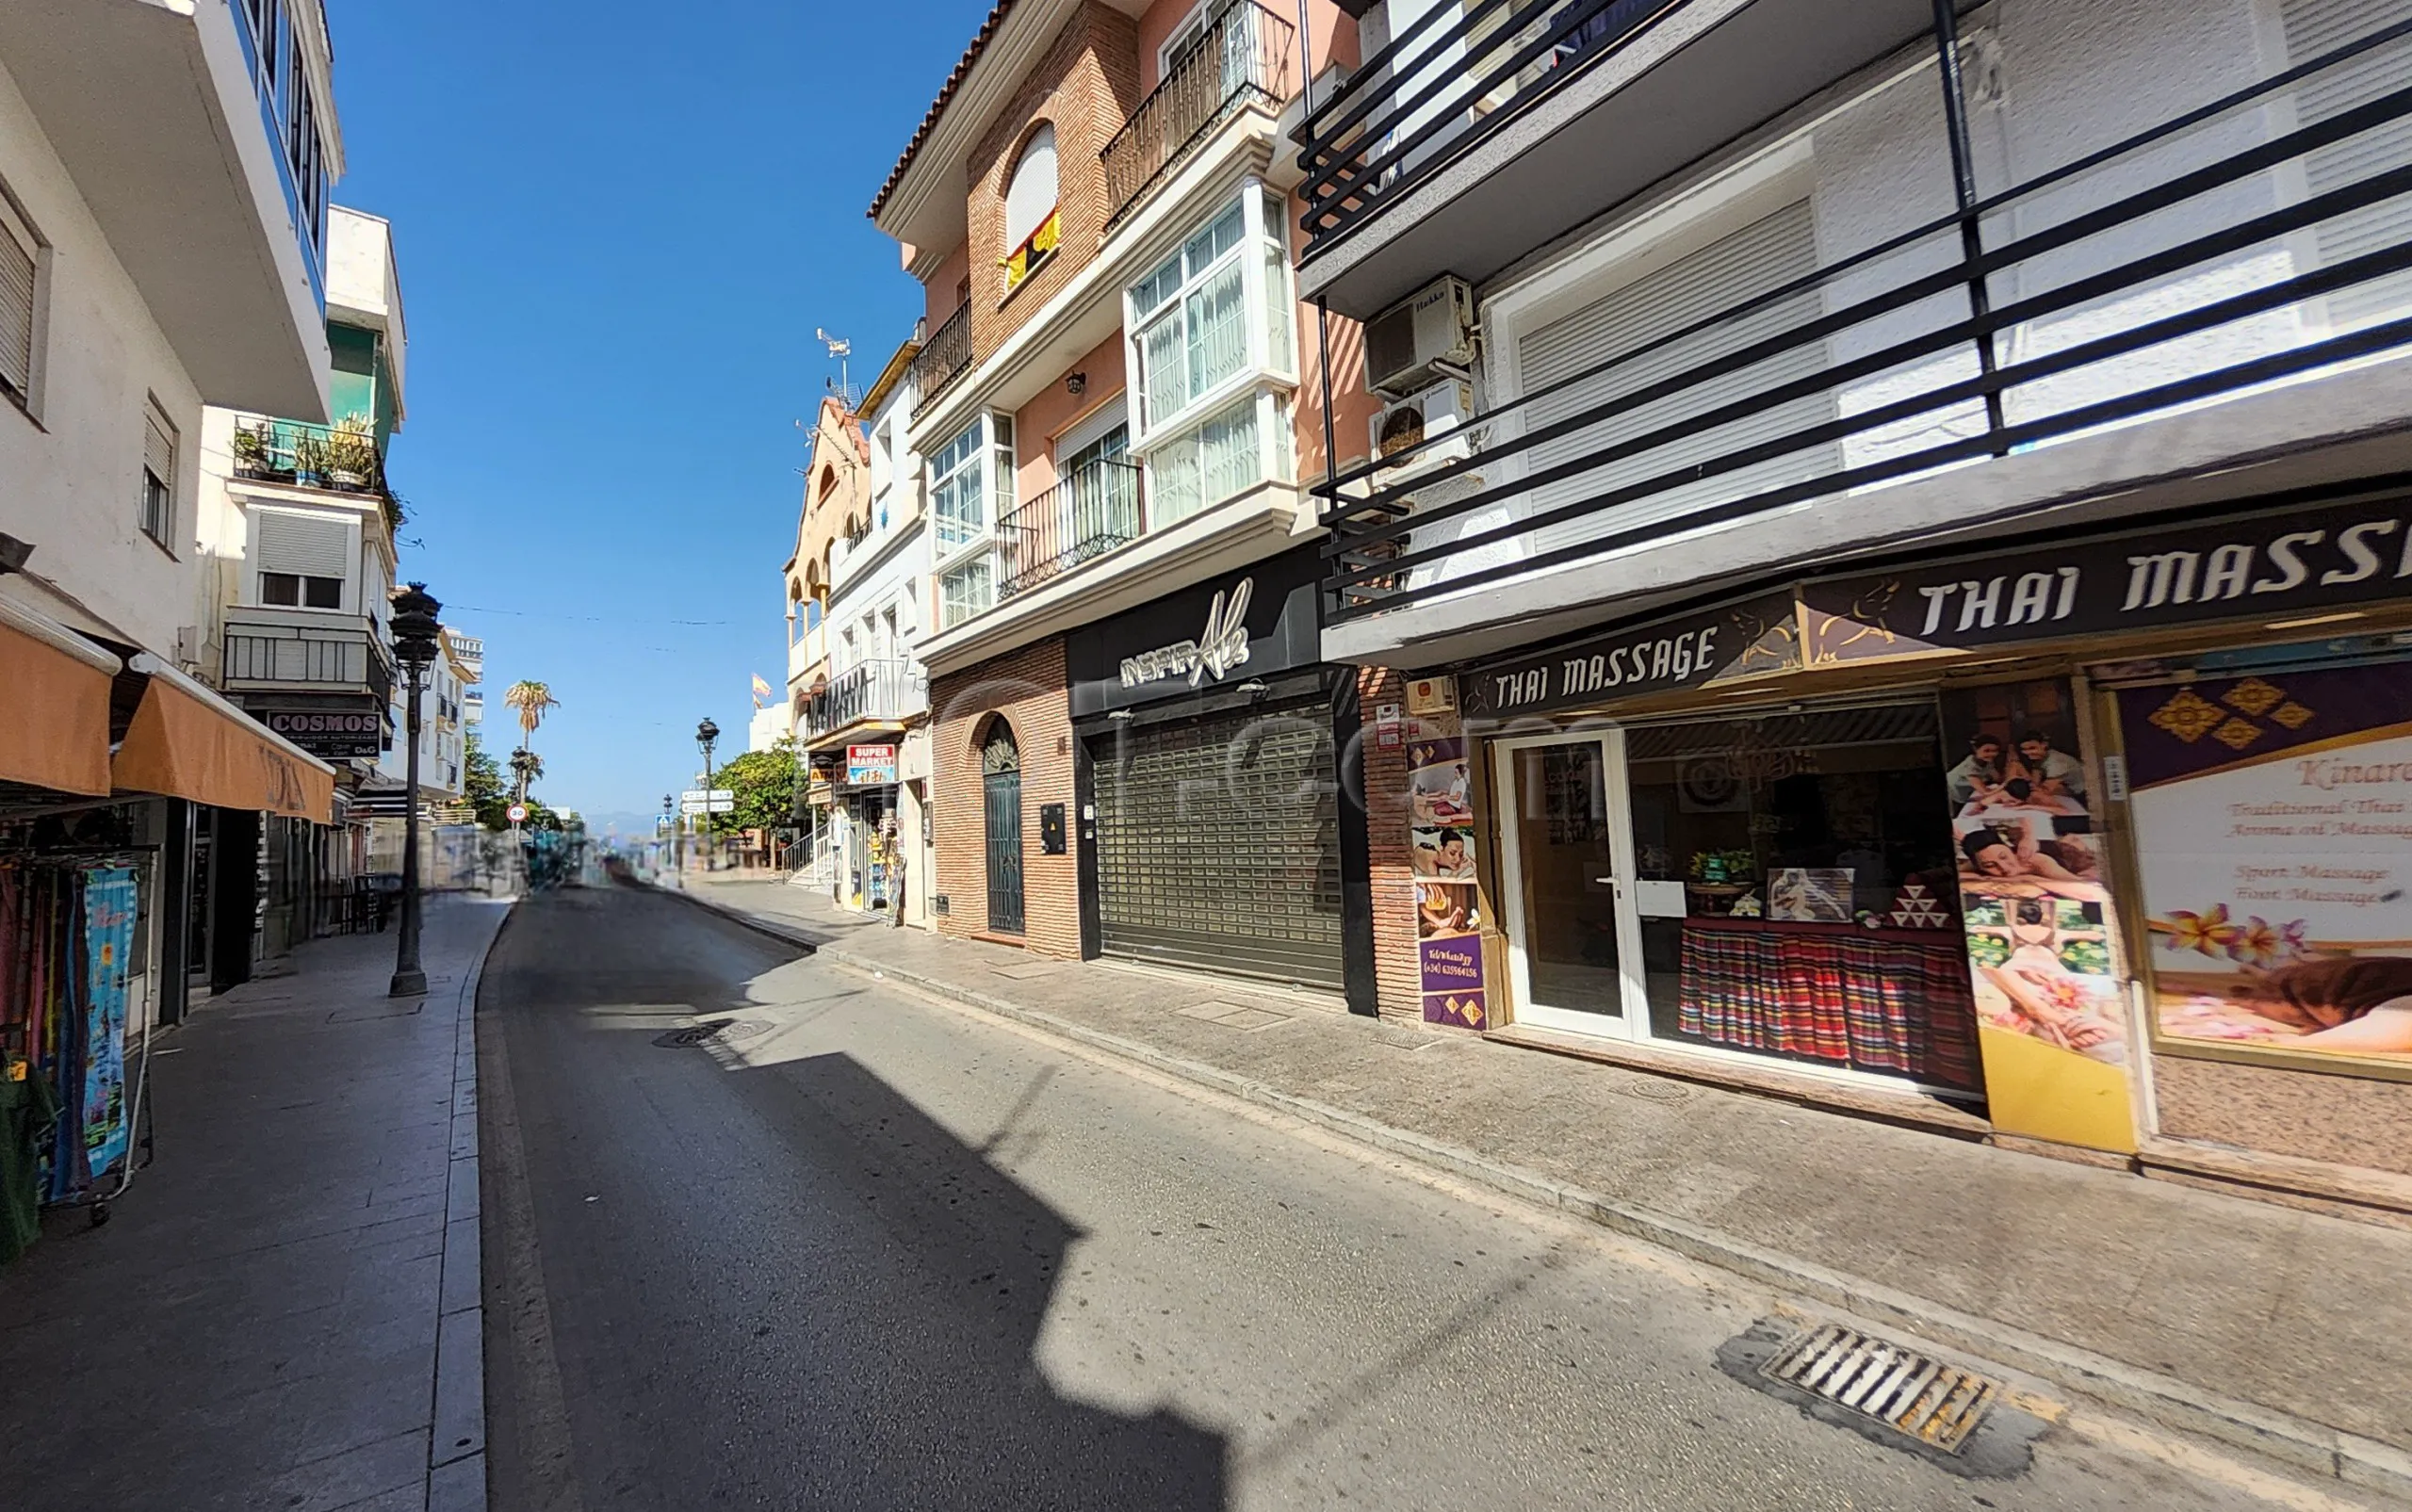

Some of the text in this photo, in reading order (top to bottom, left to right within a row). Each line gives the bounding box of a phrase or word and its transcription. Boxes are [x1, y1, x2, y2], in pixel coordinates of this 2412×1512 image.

[1918, 567, 2080, 636] THAI
[1496, 626, 1719, 708] THAI MASSAGE
[272, 715, 377, 732] COSMOS
[354, 746, 376, 755] D&G
[856, 747, 888, 756] SUPER
[852, 756, 893, 766] MARKET
